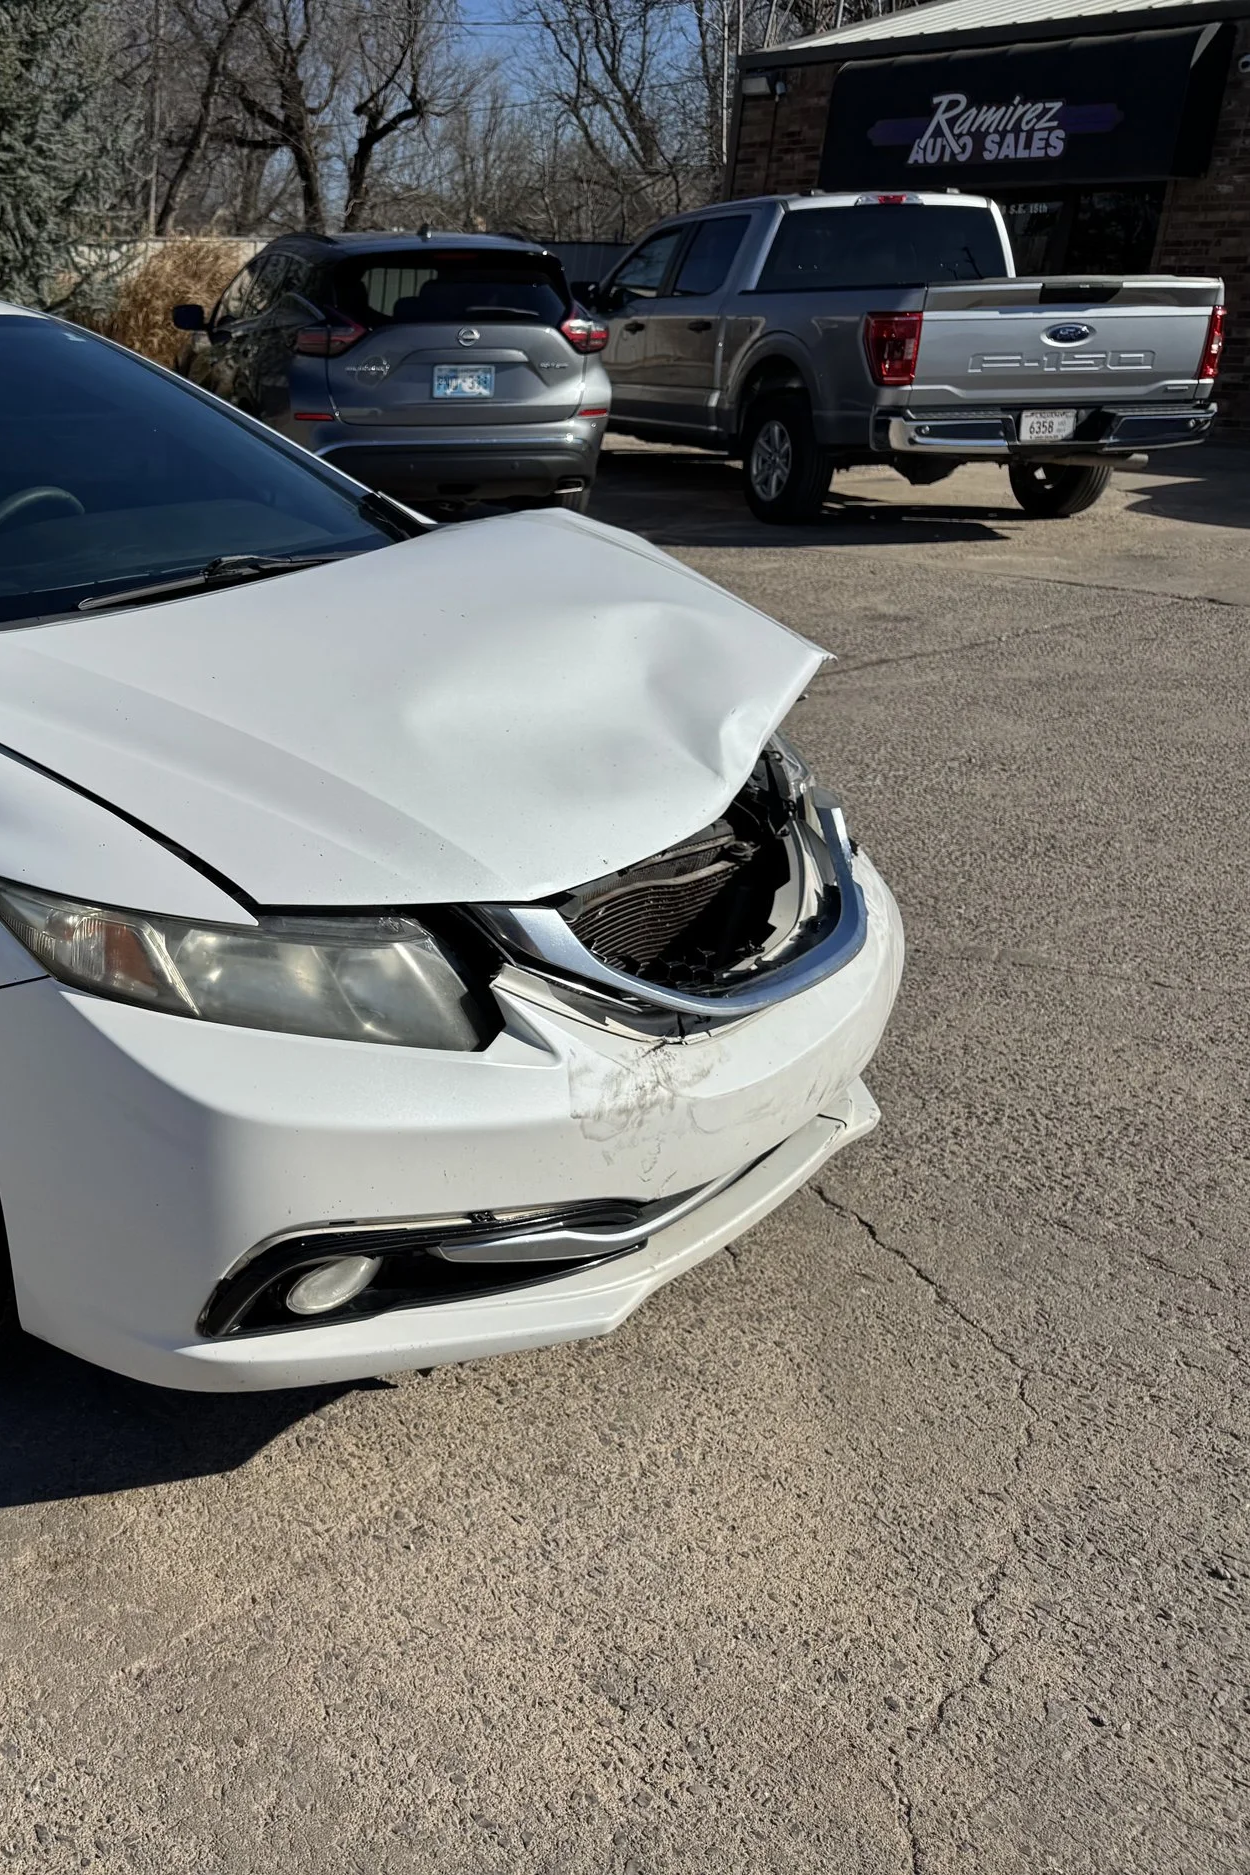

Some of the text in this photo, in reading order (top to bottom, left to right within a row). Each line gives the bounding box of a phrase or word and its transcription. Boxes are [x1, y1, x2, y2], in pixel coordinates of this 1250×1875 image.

[919, 93, 1063, 154] Ramirez
[907, 129, 1066, 164] AUTO SALES
[967, 350, 1156, 373] F-150
[1029, 420, 1054, 435] 6358
